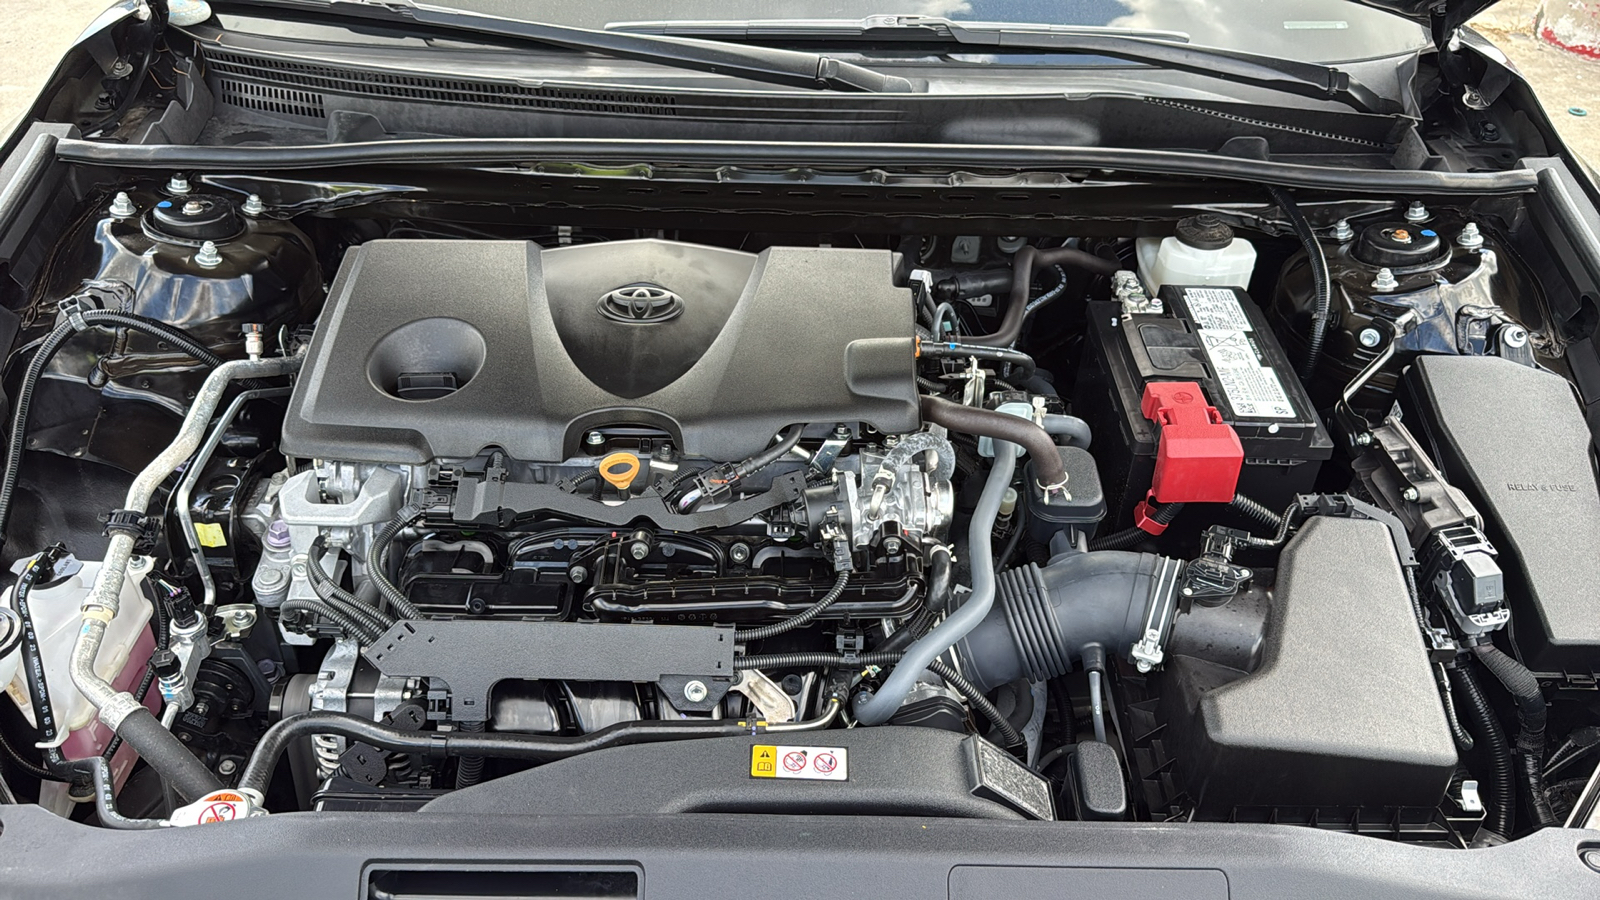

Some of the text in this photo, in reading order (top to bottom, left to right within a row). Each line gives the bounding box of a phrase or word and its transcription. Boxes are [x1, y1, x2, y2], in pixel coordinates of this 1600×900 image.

[1506, 483, 1539, 491] RELAY
[1549, 484, 1577, 492] FUSE
[29, 644, 37, 652] 23
[32, 656, 42, 678] WATER
